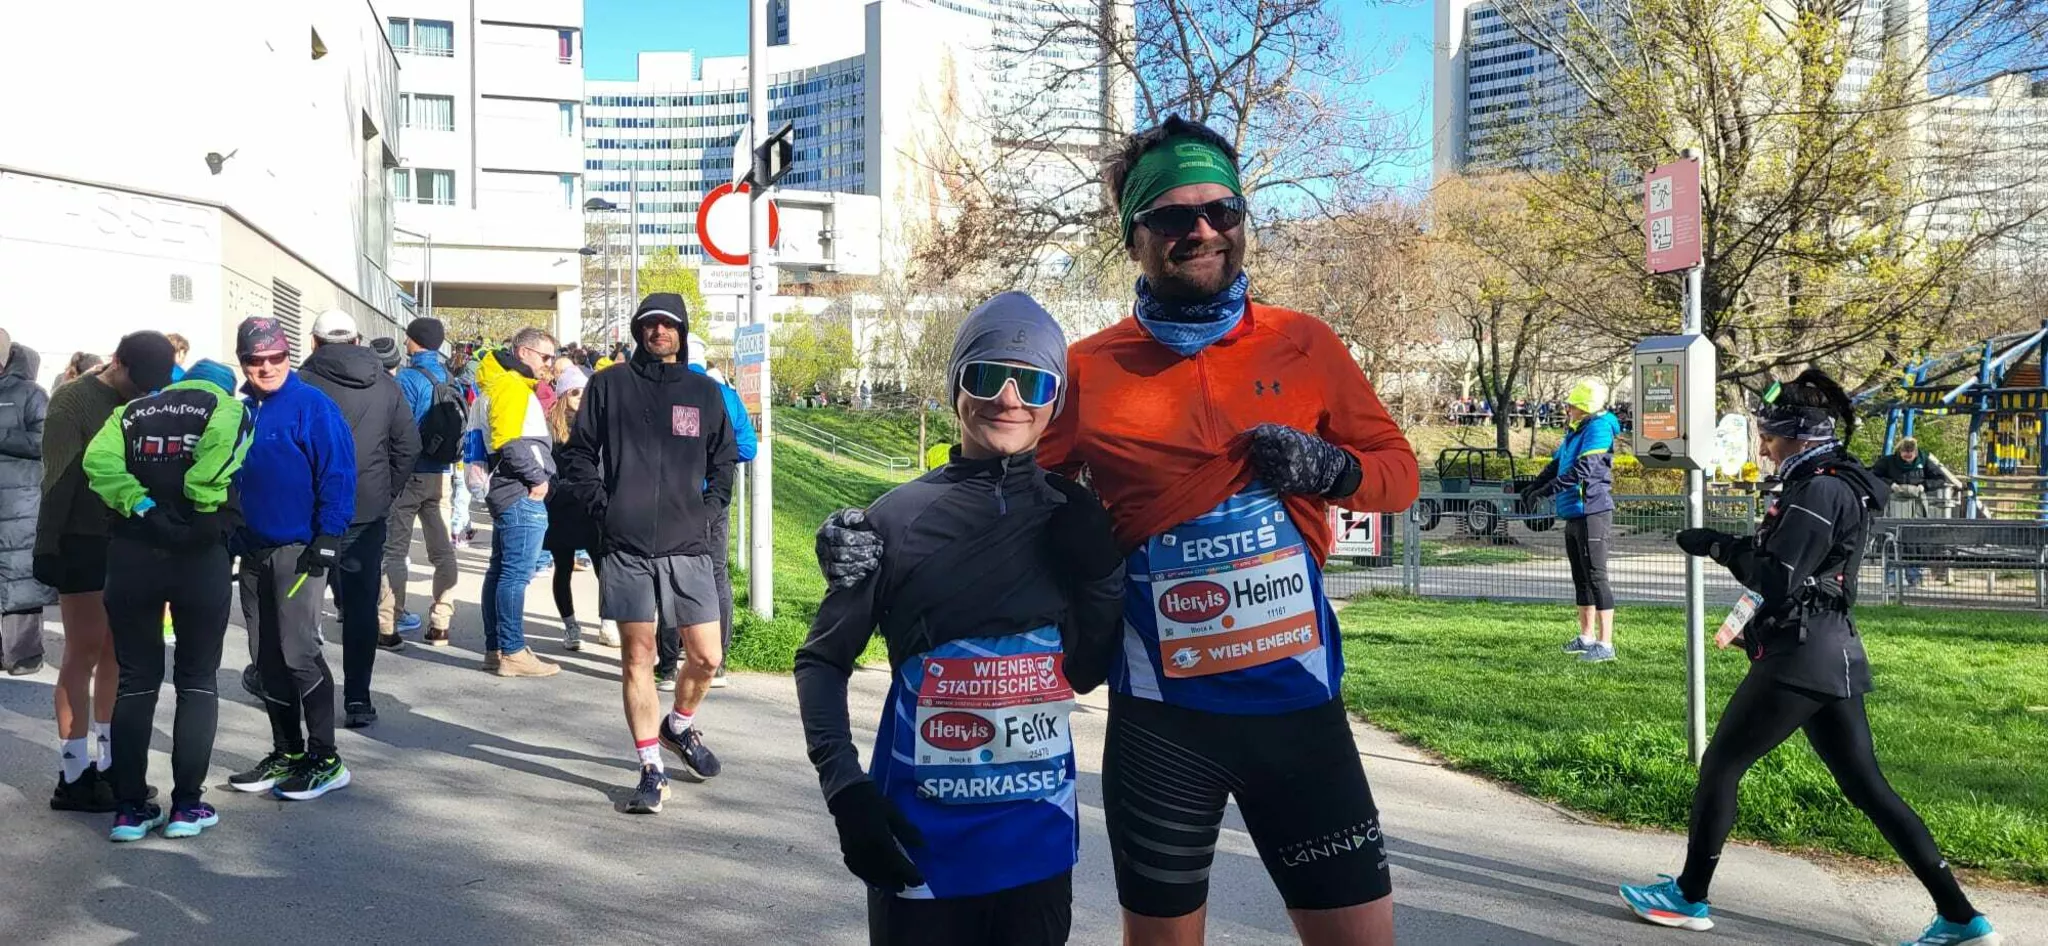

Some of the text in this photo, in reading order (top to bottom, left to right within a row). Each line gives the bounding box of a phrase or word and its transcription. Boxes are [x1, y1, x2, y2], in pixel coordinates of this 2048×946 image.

[676, 408, 697, 418] Wien
[1182, 530, 1256, 563] ERSTE
[1165, 590, 1225, 613] Hervis
[1233, 572, 1304, 609] Heimo
[1267, 606, 1286, 619] 11161
[1208, 625, 1312, 660] WIEN ENERGIE
[973, 659, 1036, 677] WIENER
[936, 677, 1038, 695] STÄDTISCHE
[929, 720, 989, 742] Hervis
[1004, 712, 1059, 748] Felix
[923, 770, 1056, 798] SPARKASSE
